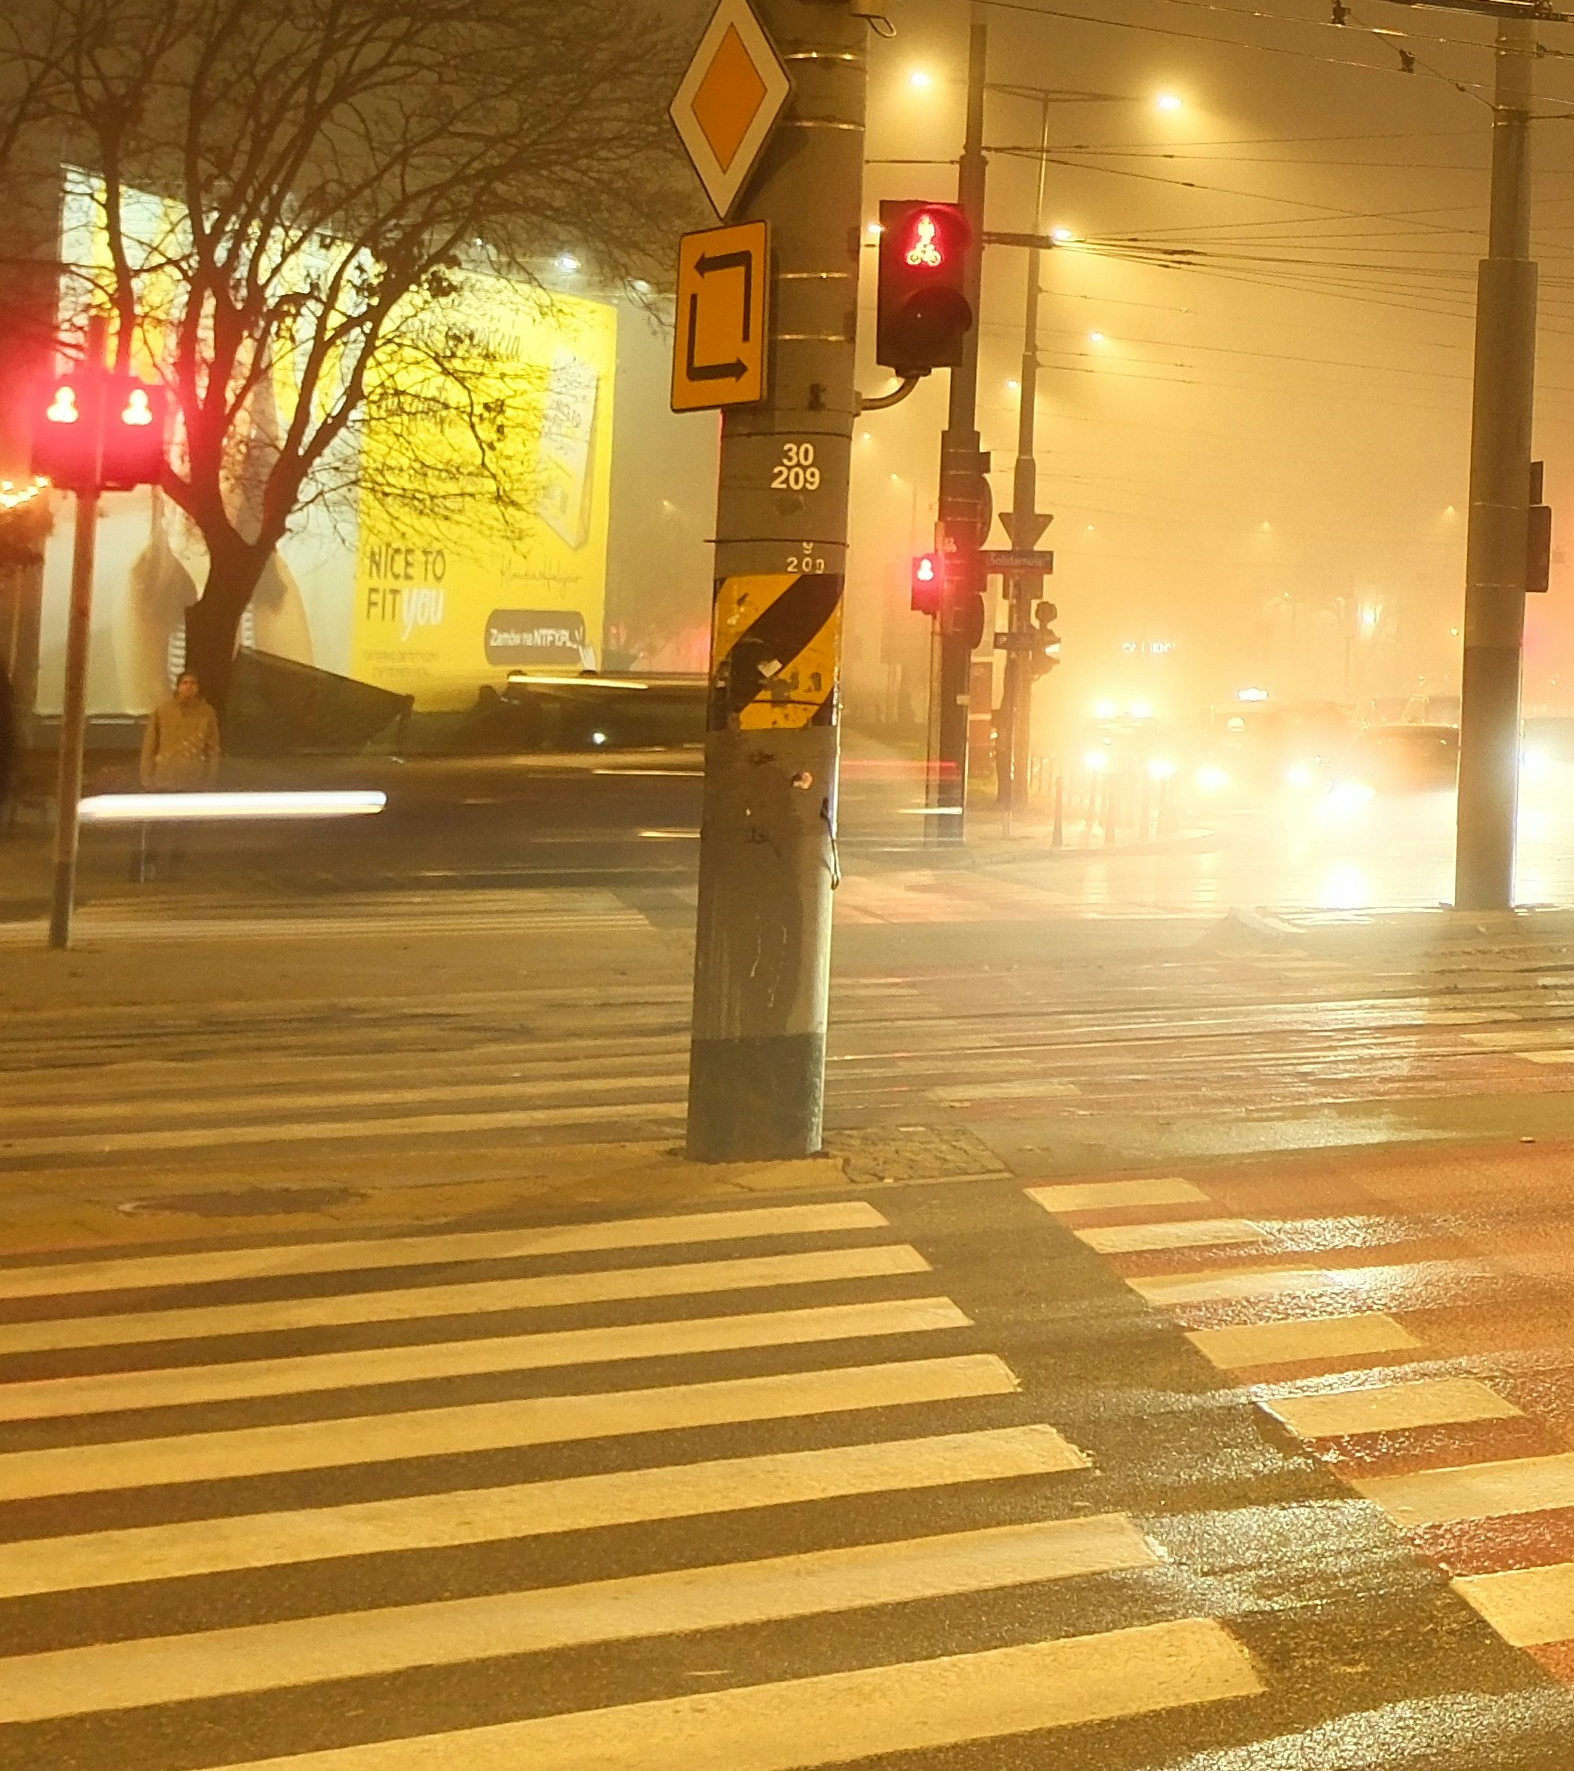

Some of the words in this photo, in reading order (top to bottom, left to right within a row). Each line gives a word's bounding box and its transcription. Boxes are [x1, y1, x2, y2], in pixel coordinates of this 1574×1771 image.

[781, 442, 814, 467] 30
[770, 465, 821, 491] 209
[369, 542, 415, 581] NICE
[423, 549, 447, 582] TO
[366, 587, 401, 622] FIT
